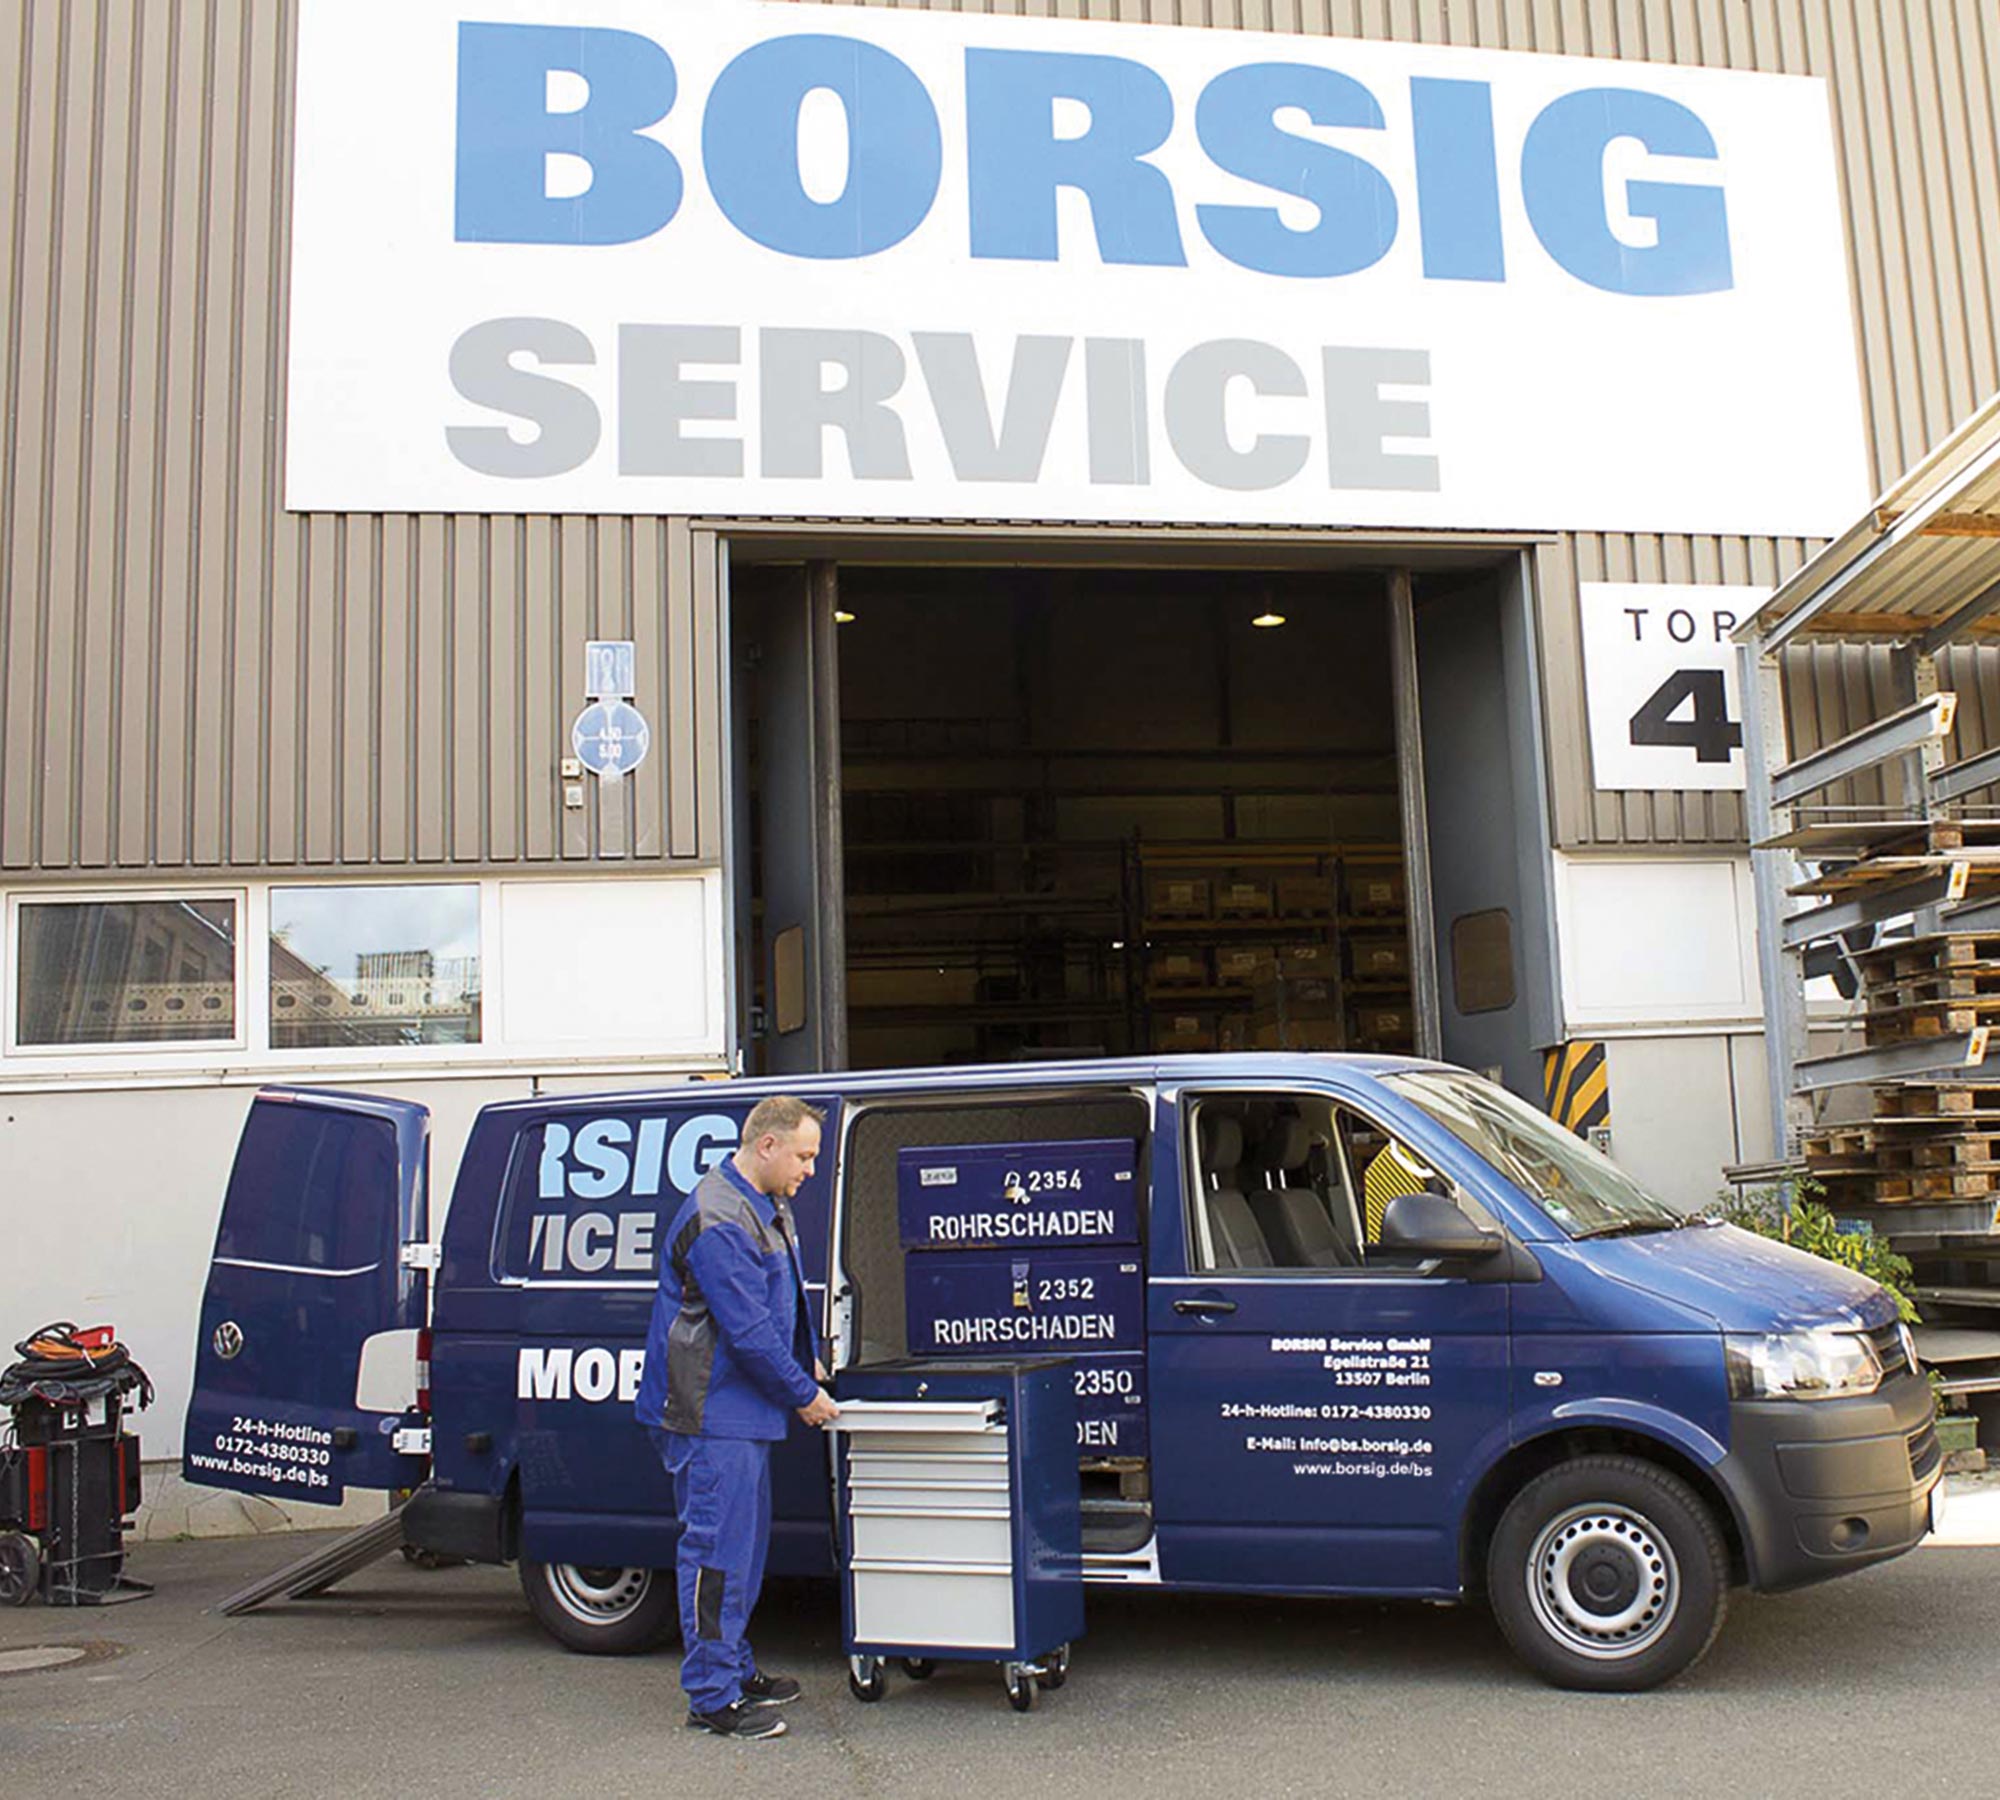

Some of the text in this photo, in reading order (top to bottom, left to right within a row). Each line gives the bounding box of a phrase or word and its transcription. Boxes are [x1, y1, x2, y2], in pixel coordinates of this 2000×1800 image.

[454, 21, 1734, 297] BORSIG
[444, 317, 1441, 492] SERVICE
[1629, 669, 1743, 763] 4
[1028, 1169, 1082, 1192] 2354
[929, 1210, 1115, 1240] ROHRSCHADEN
[528, 1212, 656, 1272] ICE
[1039, 1278, 1094, 1301] 2352
[934, 1315, 1115, 1344] ROHRSCHADEN
[1330, 1338, 1383, 1351] Service
[1410, 1355, 1430, 1369] 21
[1074, 1369, 1133, 1395] 2350
[1335, 1372, 1431, 1386] 13507 Berlin
[1221, 1404, 1432, 1420] 24-h-Hotline: 0172-4380330
[232, 1416, 332, 1444] 24-h-Hotline
[1076, 1421, 1118, 1445] EN
[215, 1434, 330, 1466] 0172-4380330
[1246, 1437, 1433, 1455] E-Mail: info@bs.borsig.de
[1293, 1461, 1433, 1478] www.borsig.de/bs
